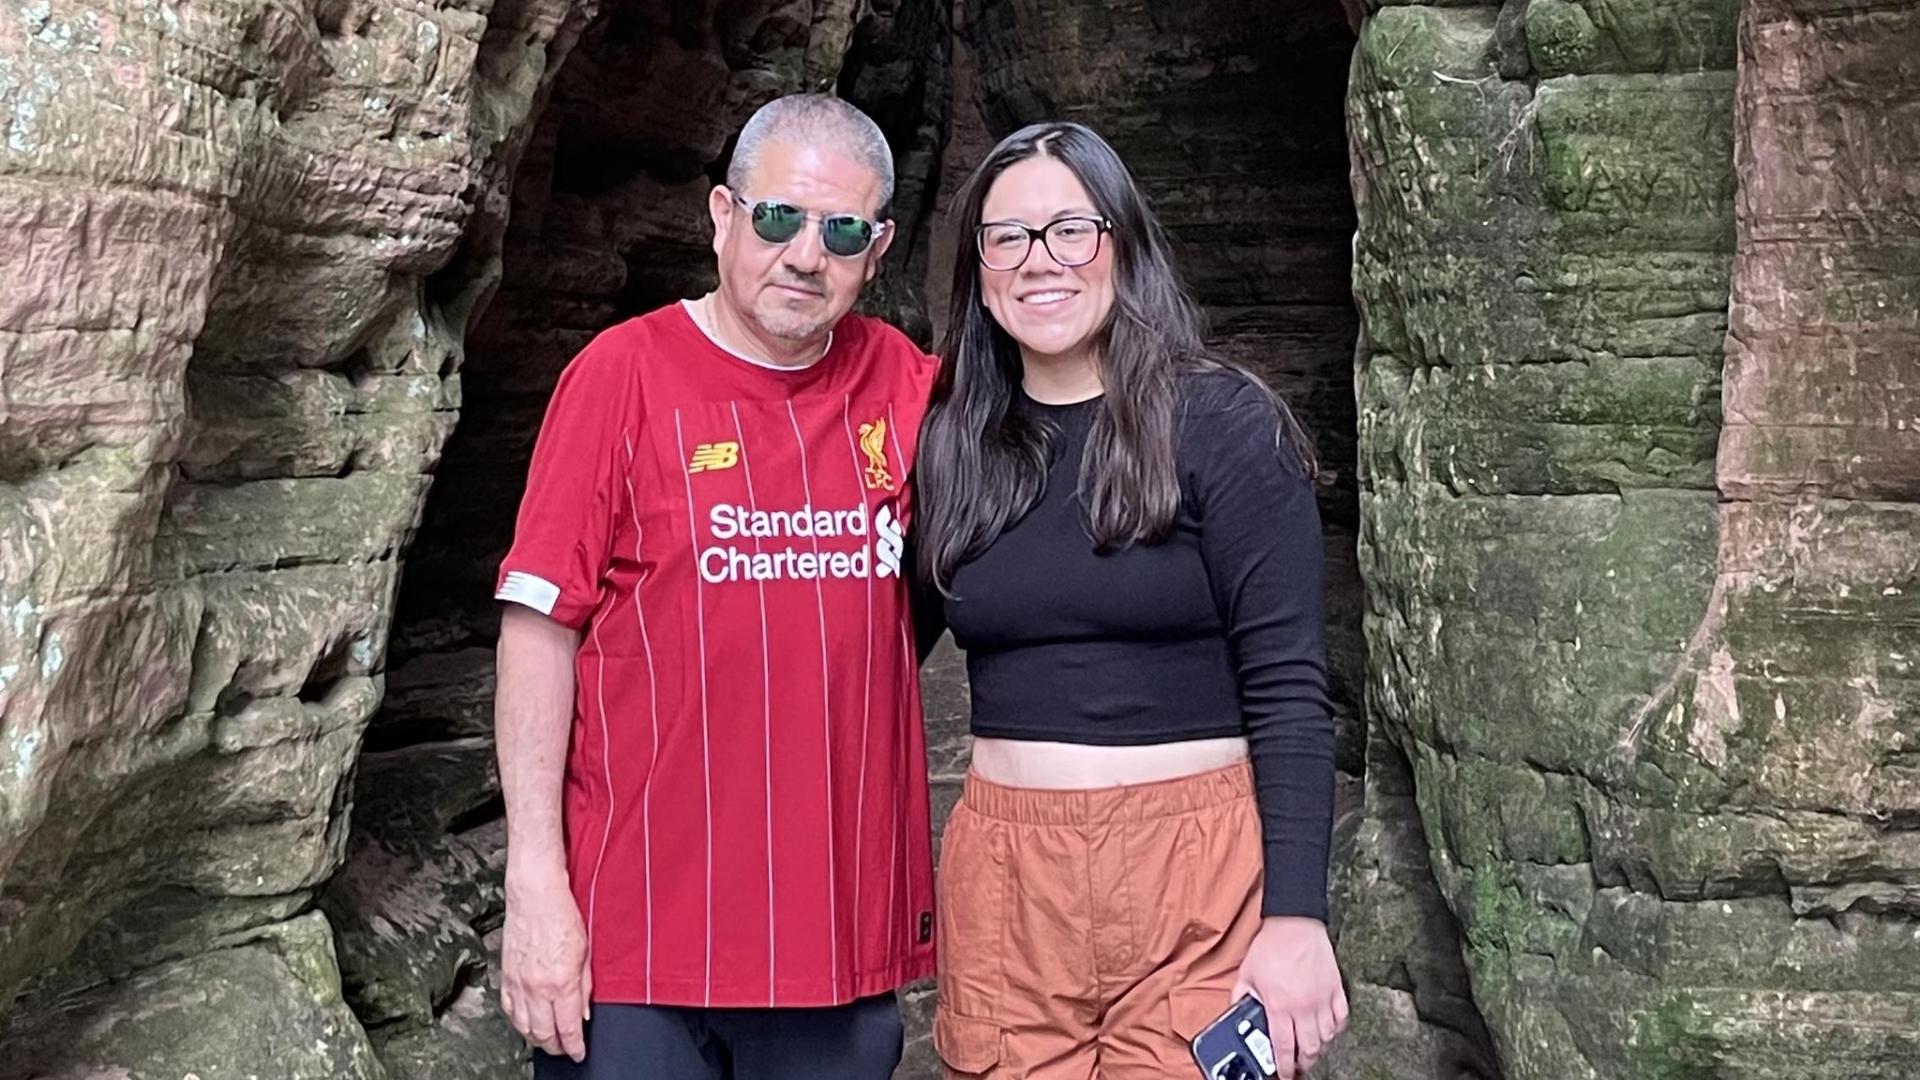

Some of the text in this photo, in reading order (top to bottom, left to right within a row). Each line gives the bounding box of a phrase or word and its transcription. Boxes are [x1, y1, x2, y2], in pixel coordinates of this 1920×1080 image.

[865, 473, 895, 491] LFC
[710, 503, 867, 539] Standard
[701, 546, 869, 583] Chartered
